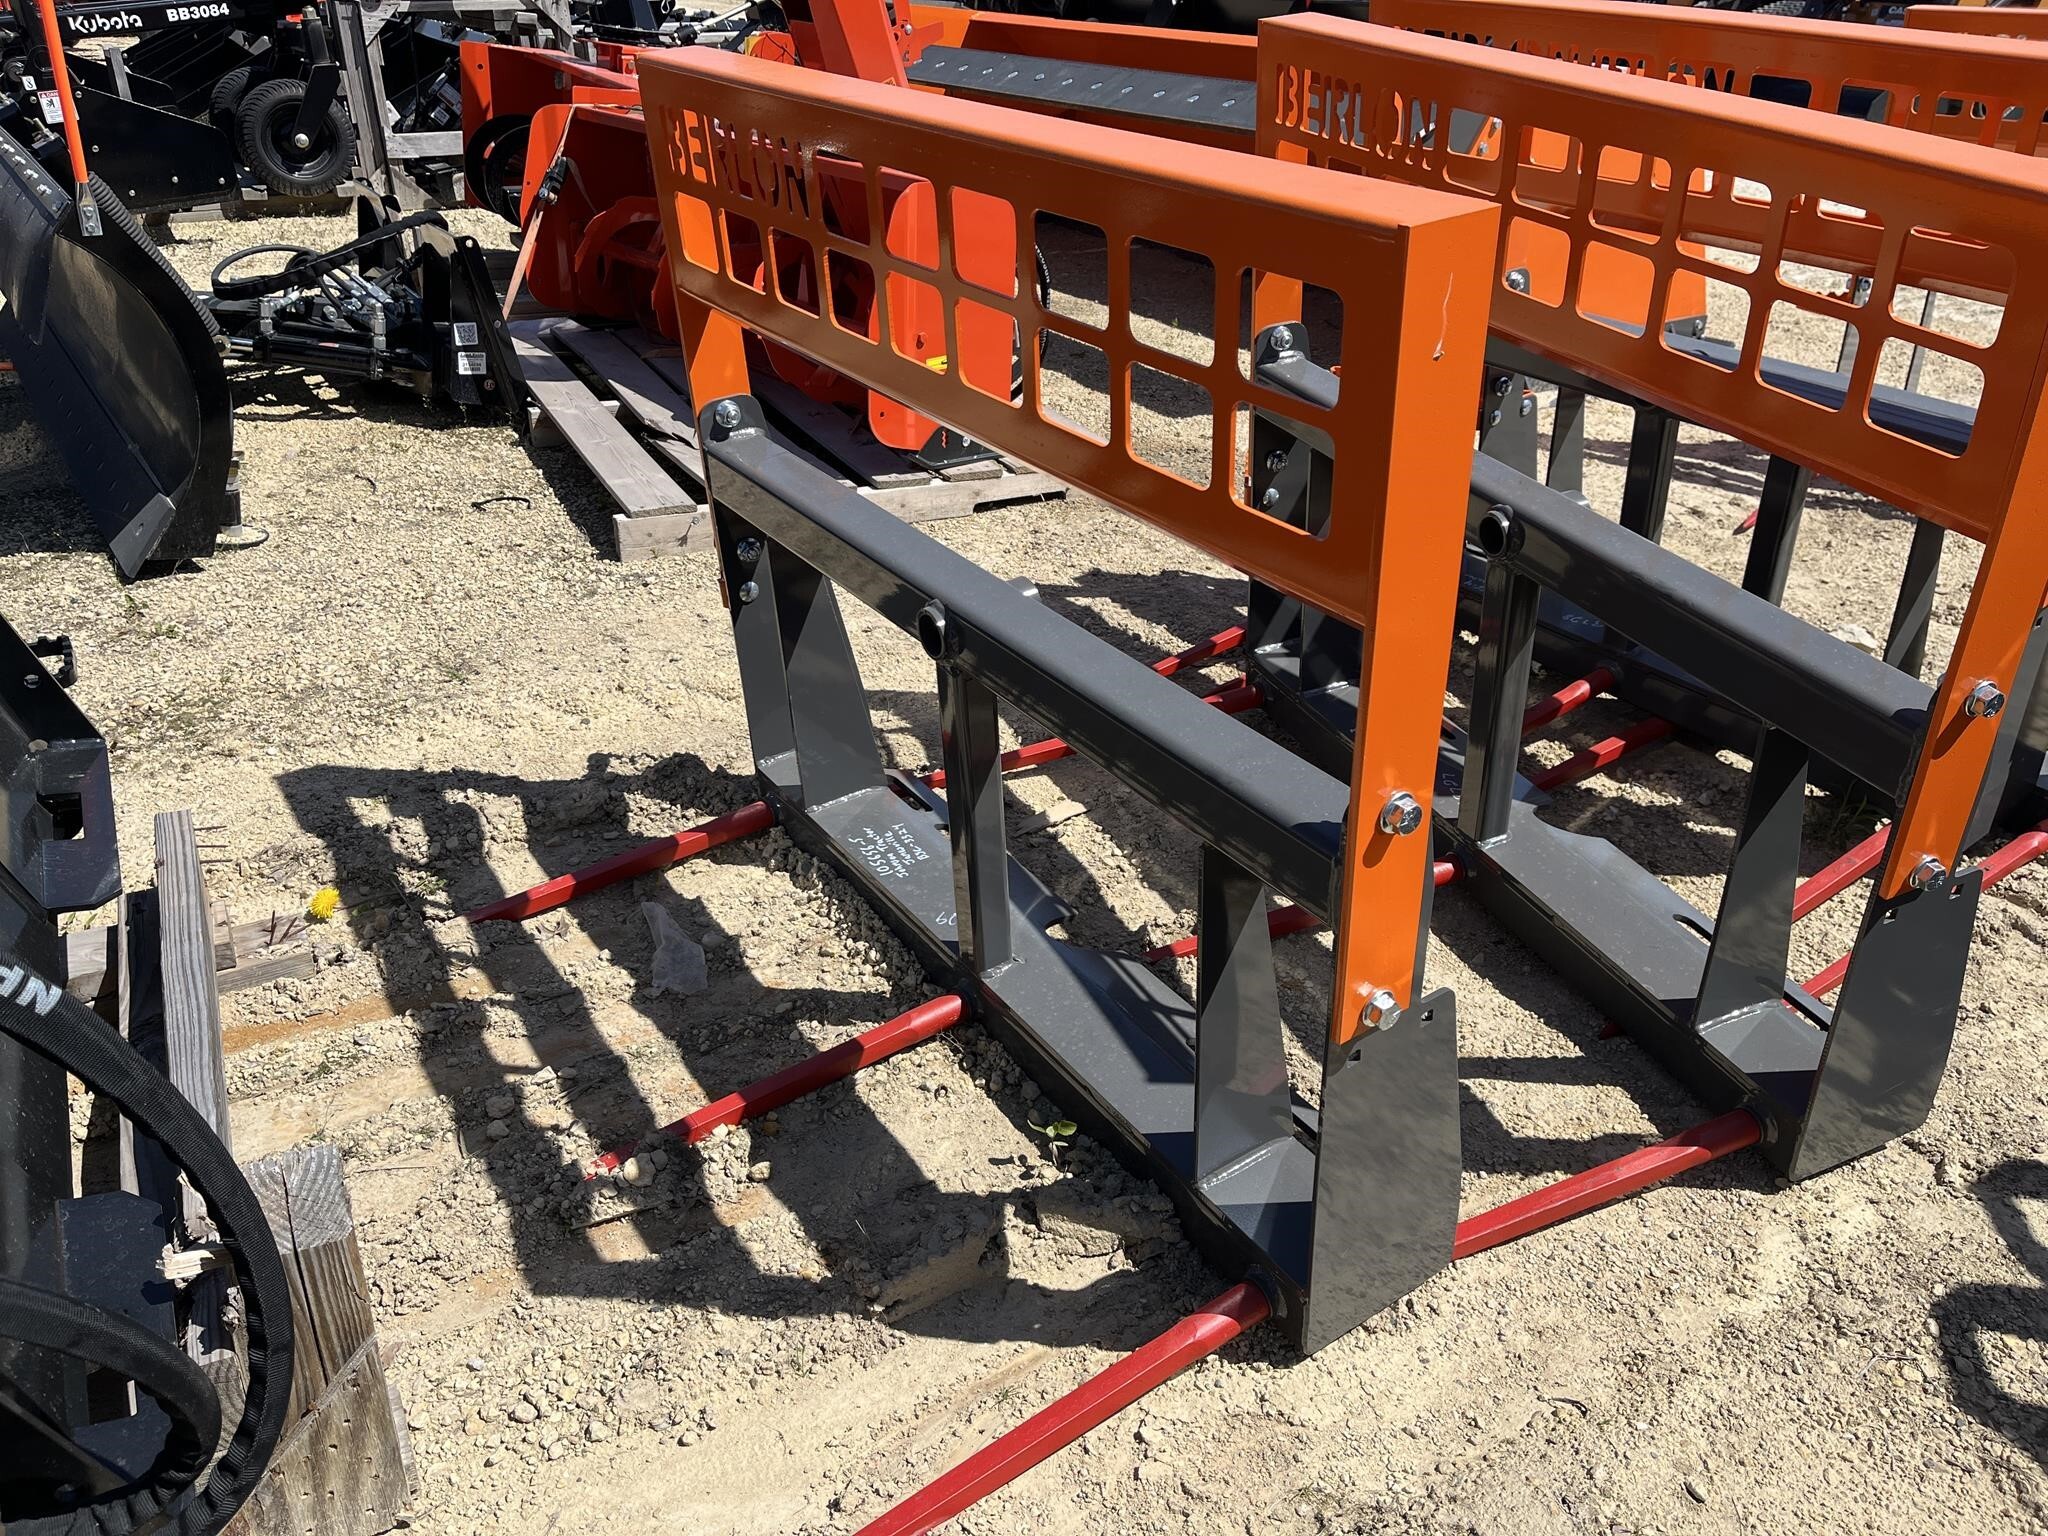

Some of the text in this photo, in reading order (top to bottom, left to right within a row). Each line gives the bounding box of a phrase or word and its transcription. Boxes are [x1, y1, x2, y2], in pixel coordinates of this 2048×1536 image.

[67, 3, 230, 34] Kubota BB3084
[660, 104, 811, 220] BERLON
[1274, 63, 1438, 171] BERLON
